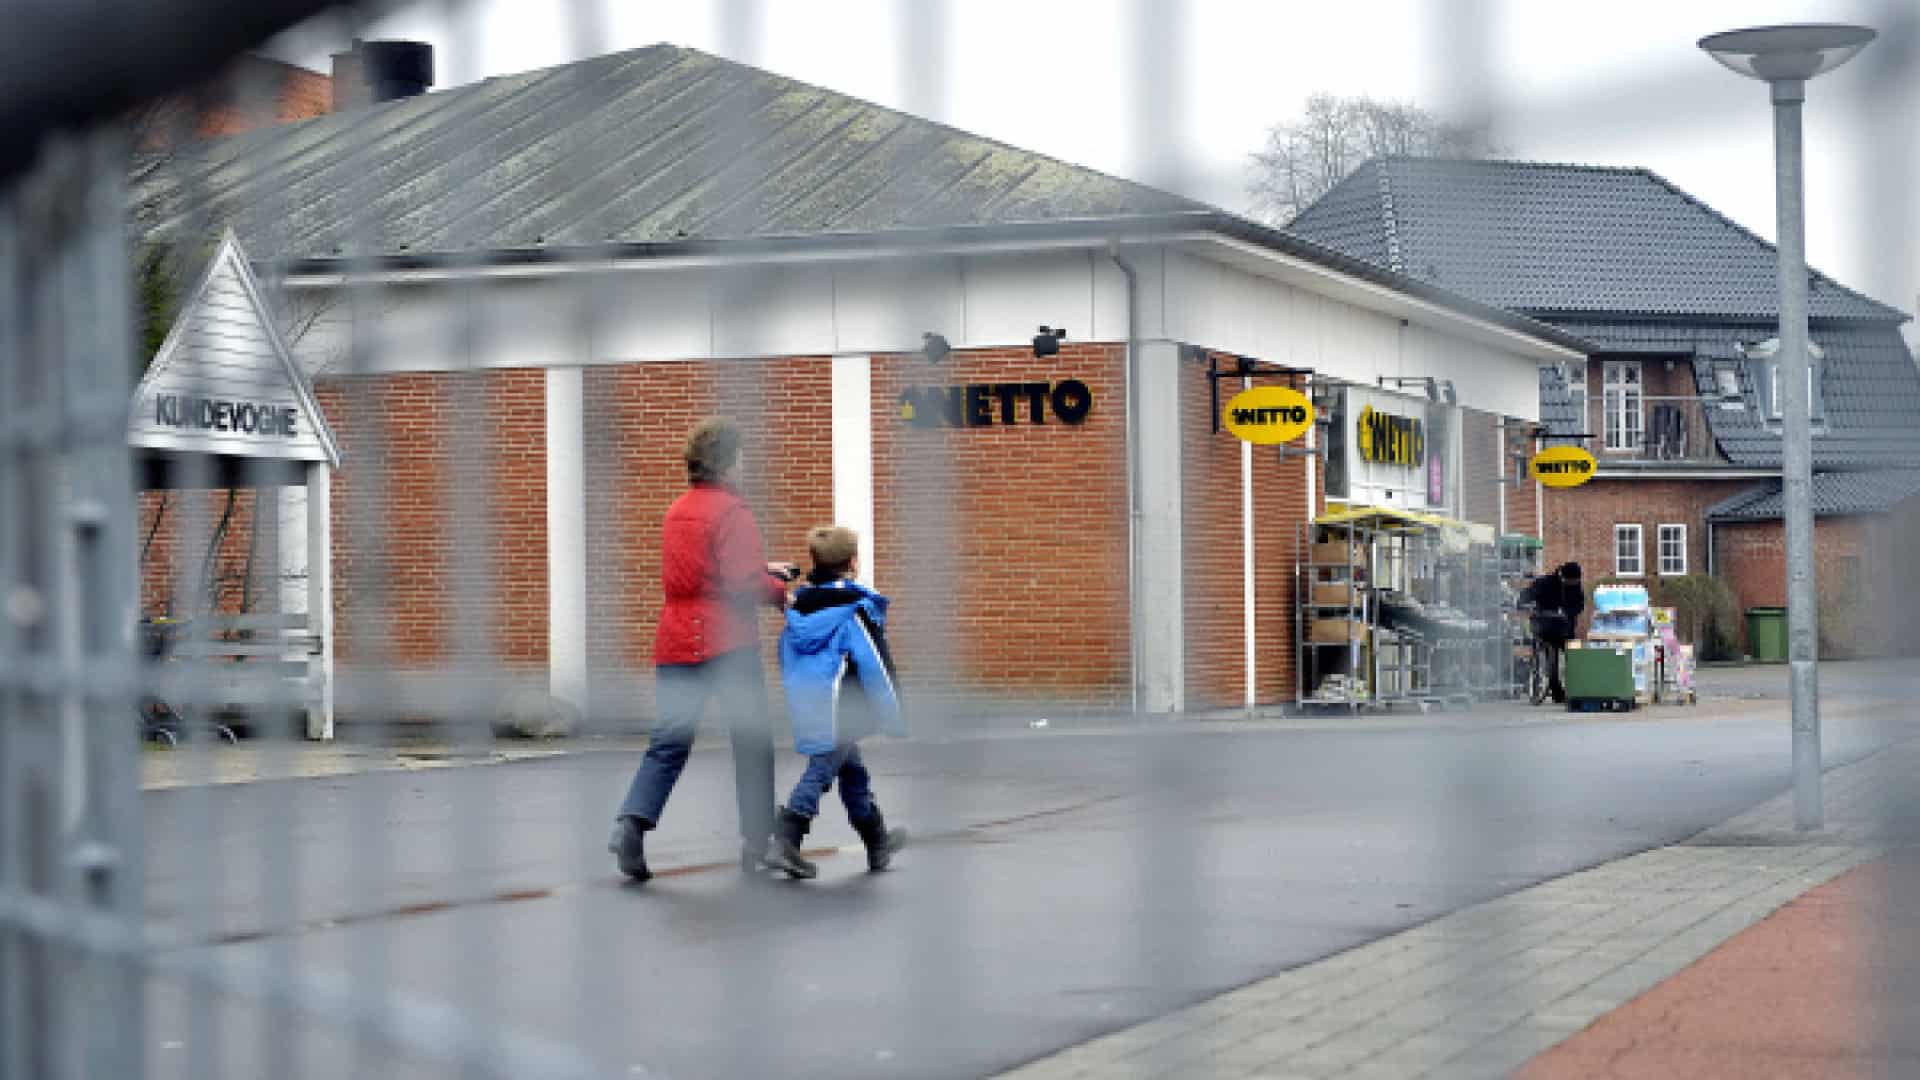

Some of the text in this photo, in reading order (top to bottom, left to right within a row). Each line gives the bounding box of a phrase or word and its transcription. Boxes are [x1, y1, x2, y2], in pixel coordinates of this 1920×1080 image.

[927, 379, 1092, 427] NETTO
[1243, 405, 1306, 425] NETTO
[1372, 411, 1425, 469] NETTO
